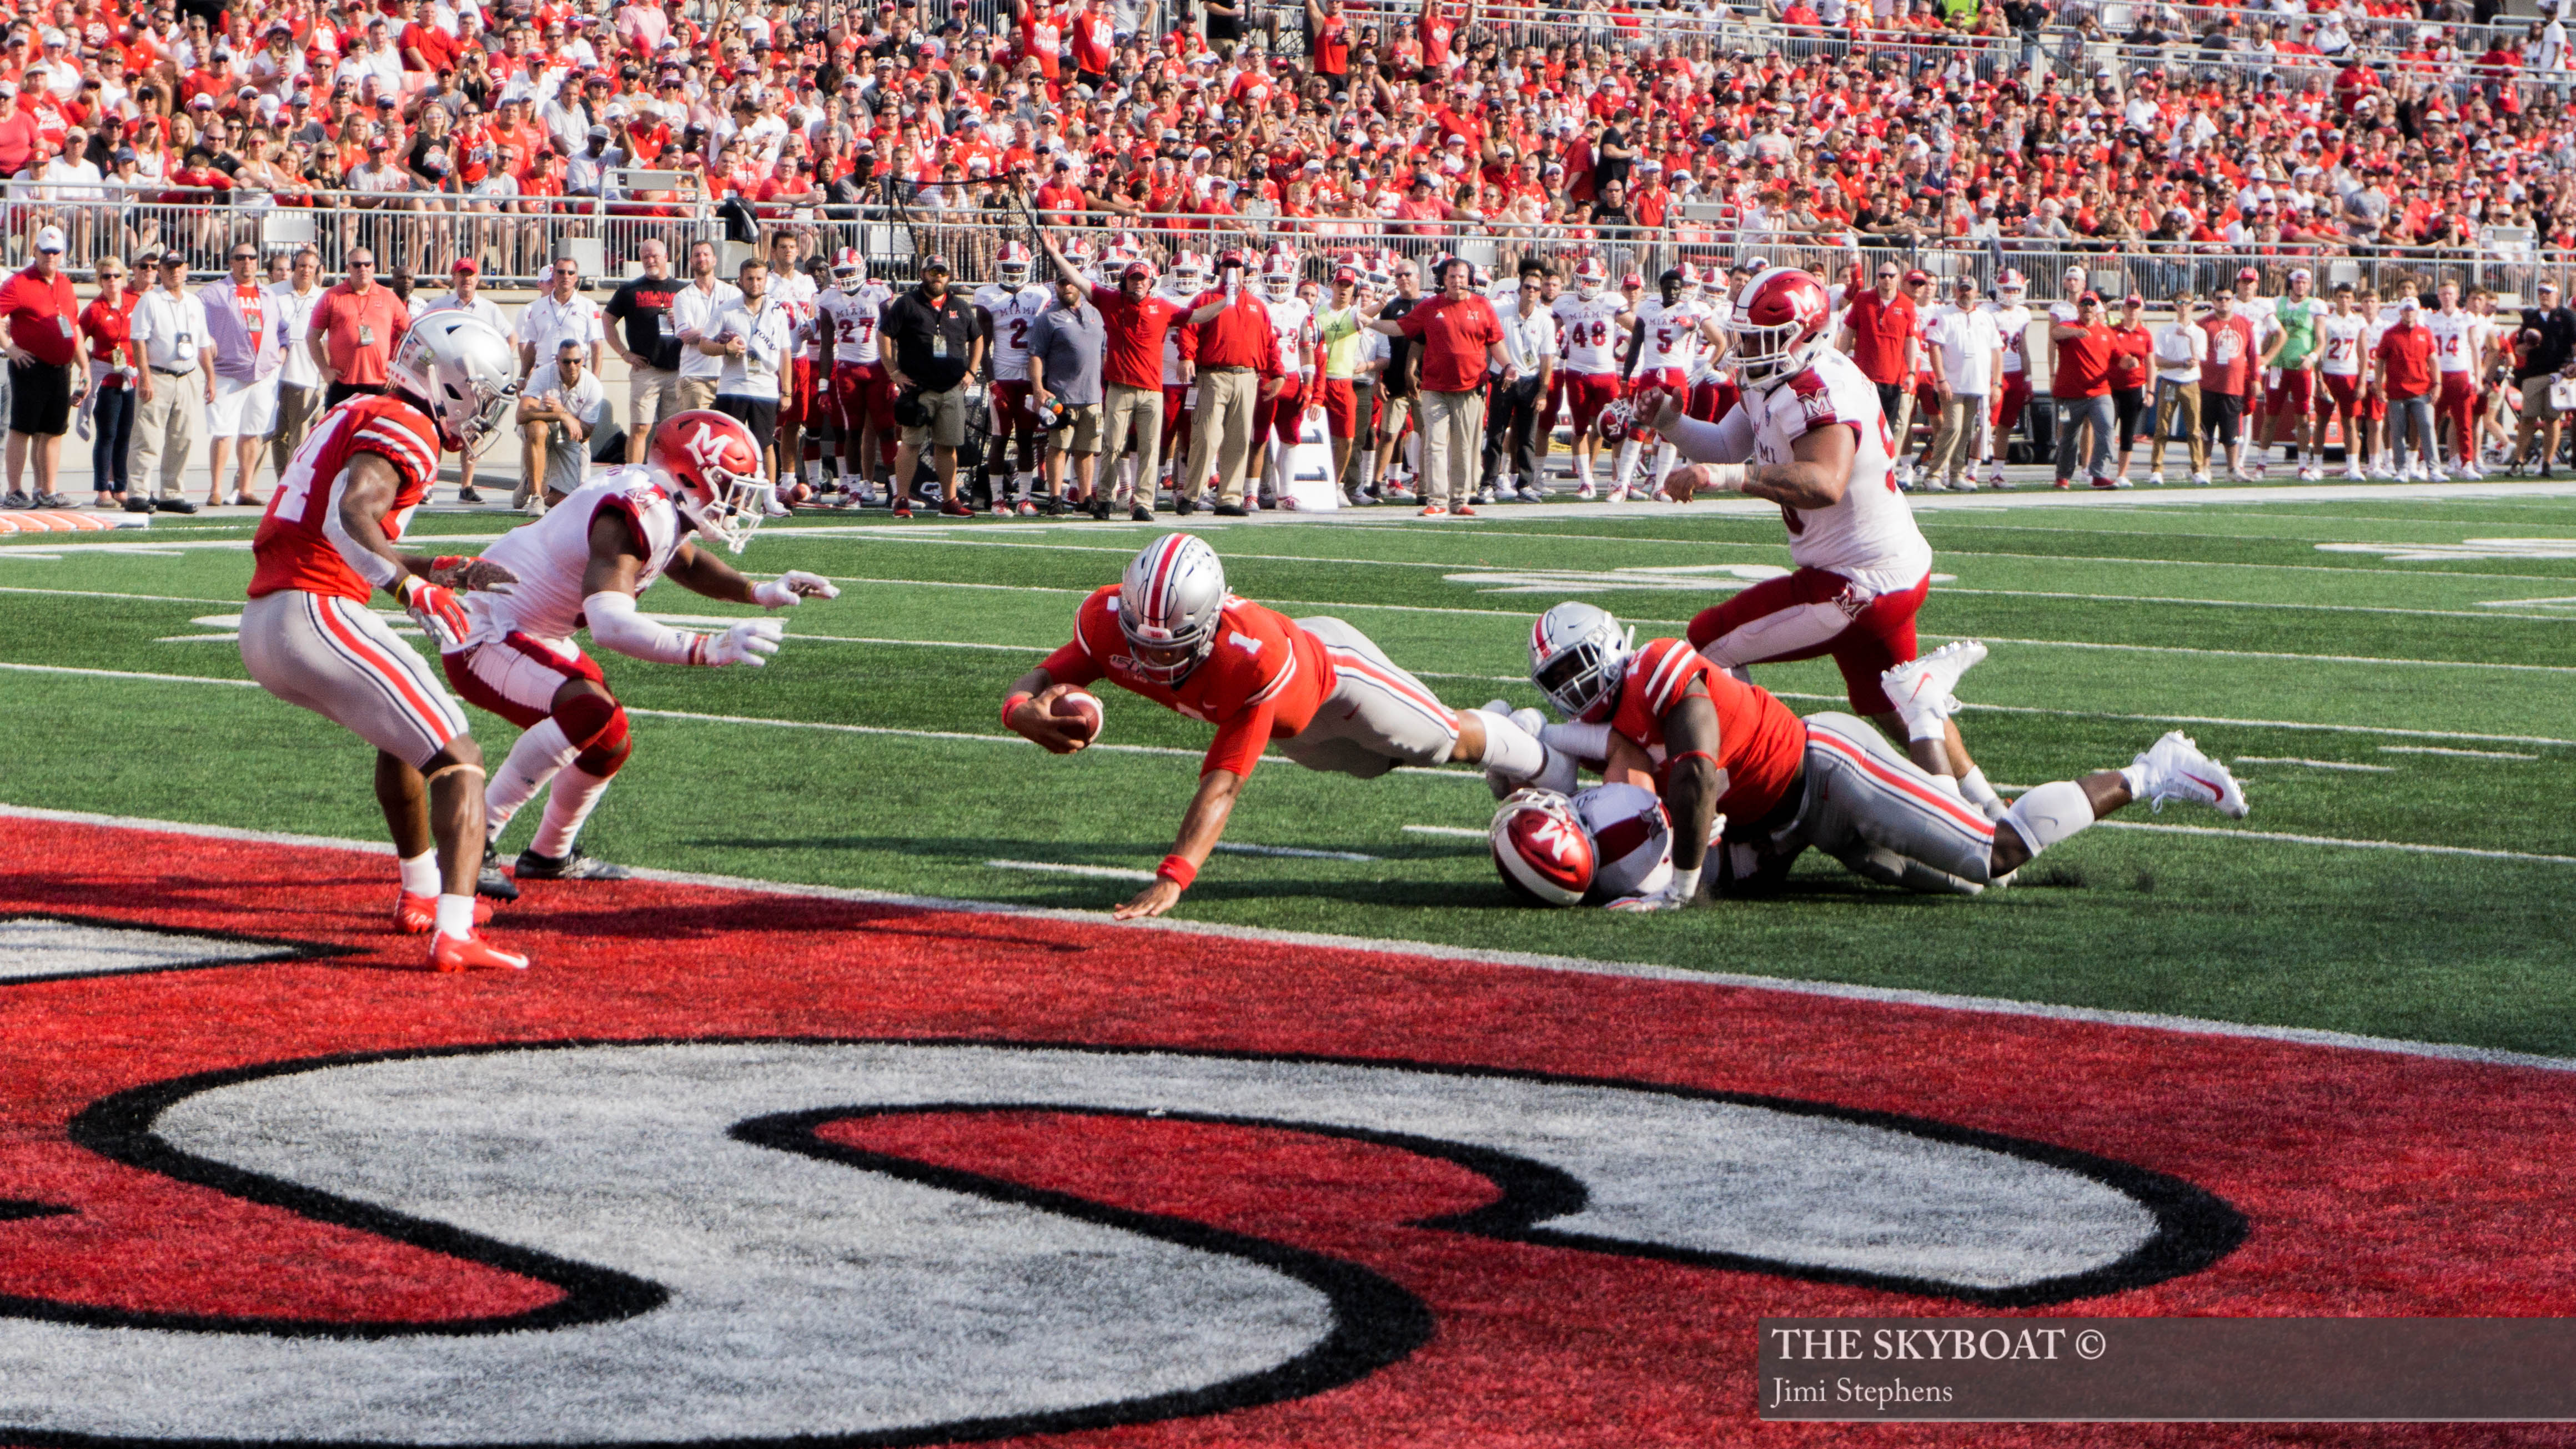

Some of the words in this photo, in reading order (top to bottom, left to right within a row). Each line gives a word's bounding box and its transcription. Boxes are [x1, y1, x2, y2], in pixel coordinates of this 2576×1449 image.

[836, 308, 873, 318] MIAMI
[1000, 307, 1036, 316] MIAMI
[1569, 311, 1604, 320] MIAMI
[839, 317, 875, 343] 27
[1010, 318, 1028, 349] 2
[1573, 321, 1606, 348] 48
[1657, 329, 1672, 354] 5
[2328, 337, 2354, 360] 27
[2434, 334, 2458, 356] 14
[1229, 630, 1262, 655] 1
